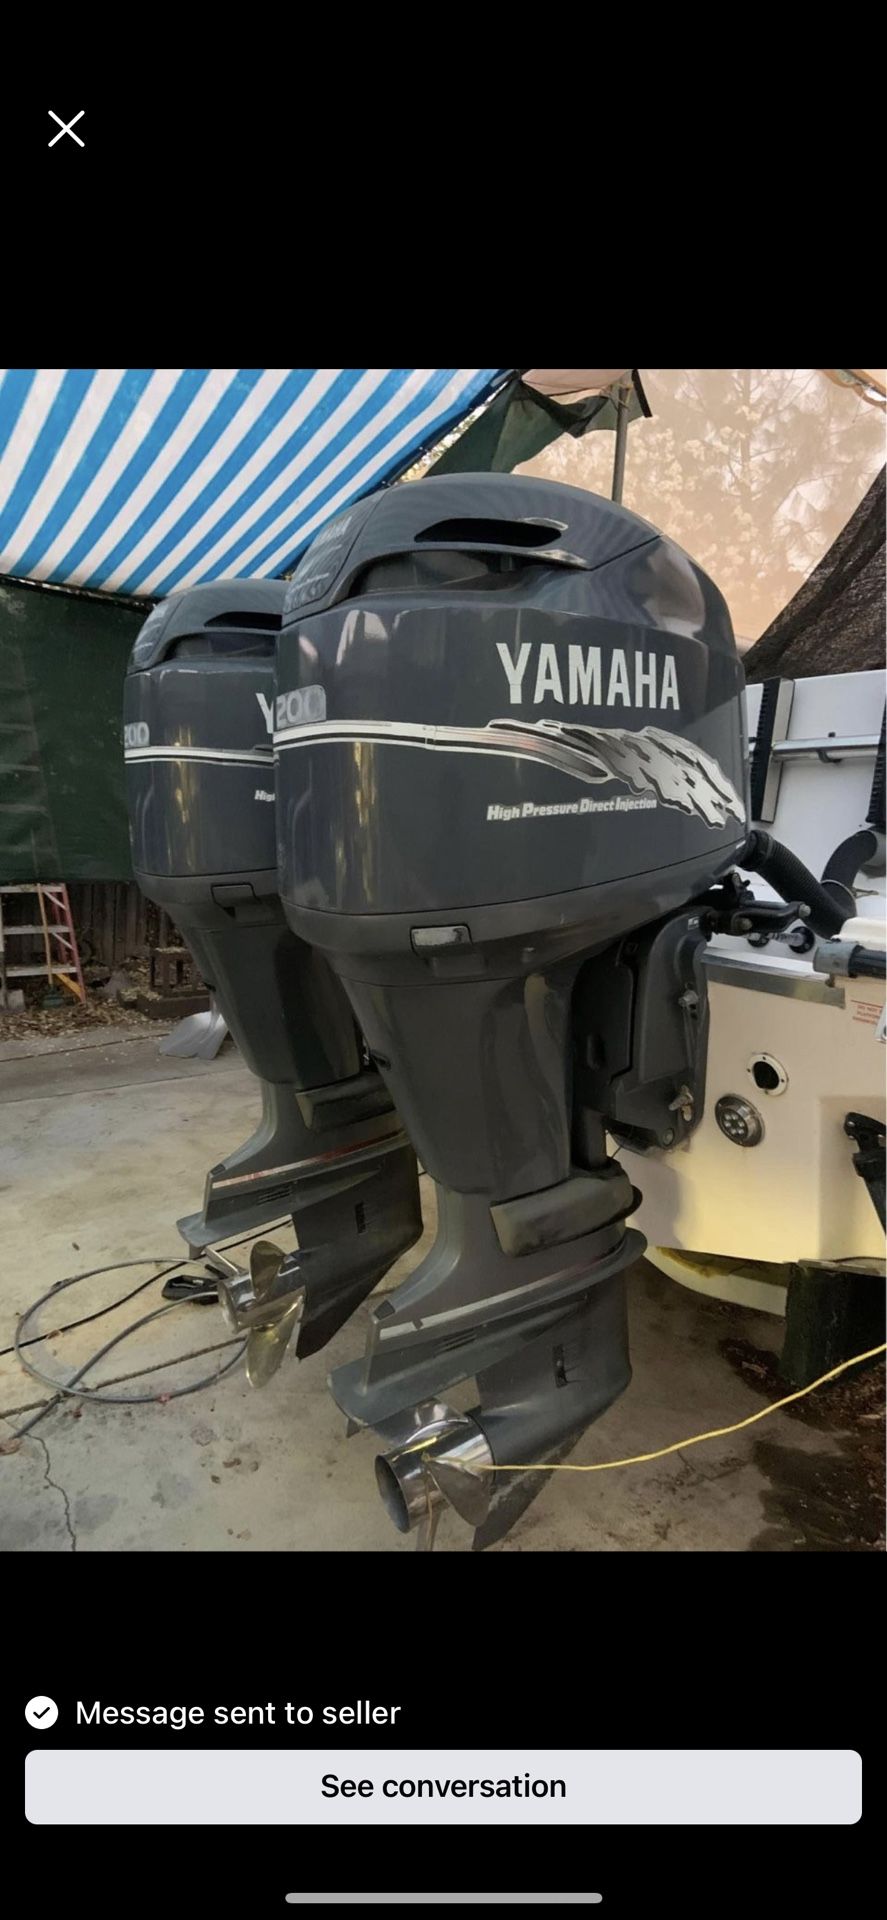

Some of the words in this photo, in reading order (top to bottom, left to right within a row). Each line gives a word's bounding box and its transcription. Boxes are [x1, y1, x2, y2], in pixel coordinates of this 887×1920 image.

[496, 642, 680, 710] YAMAHA
[487, 805, 520, 821] High
[522, 802, 578, 818] Pressure
[580, 798, 615, 813] Direct
[615, 797, 657, 812] Injection
